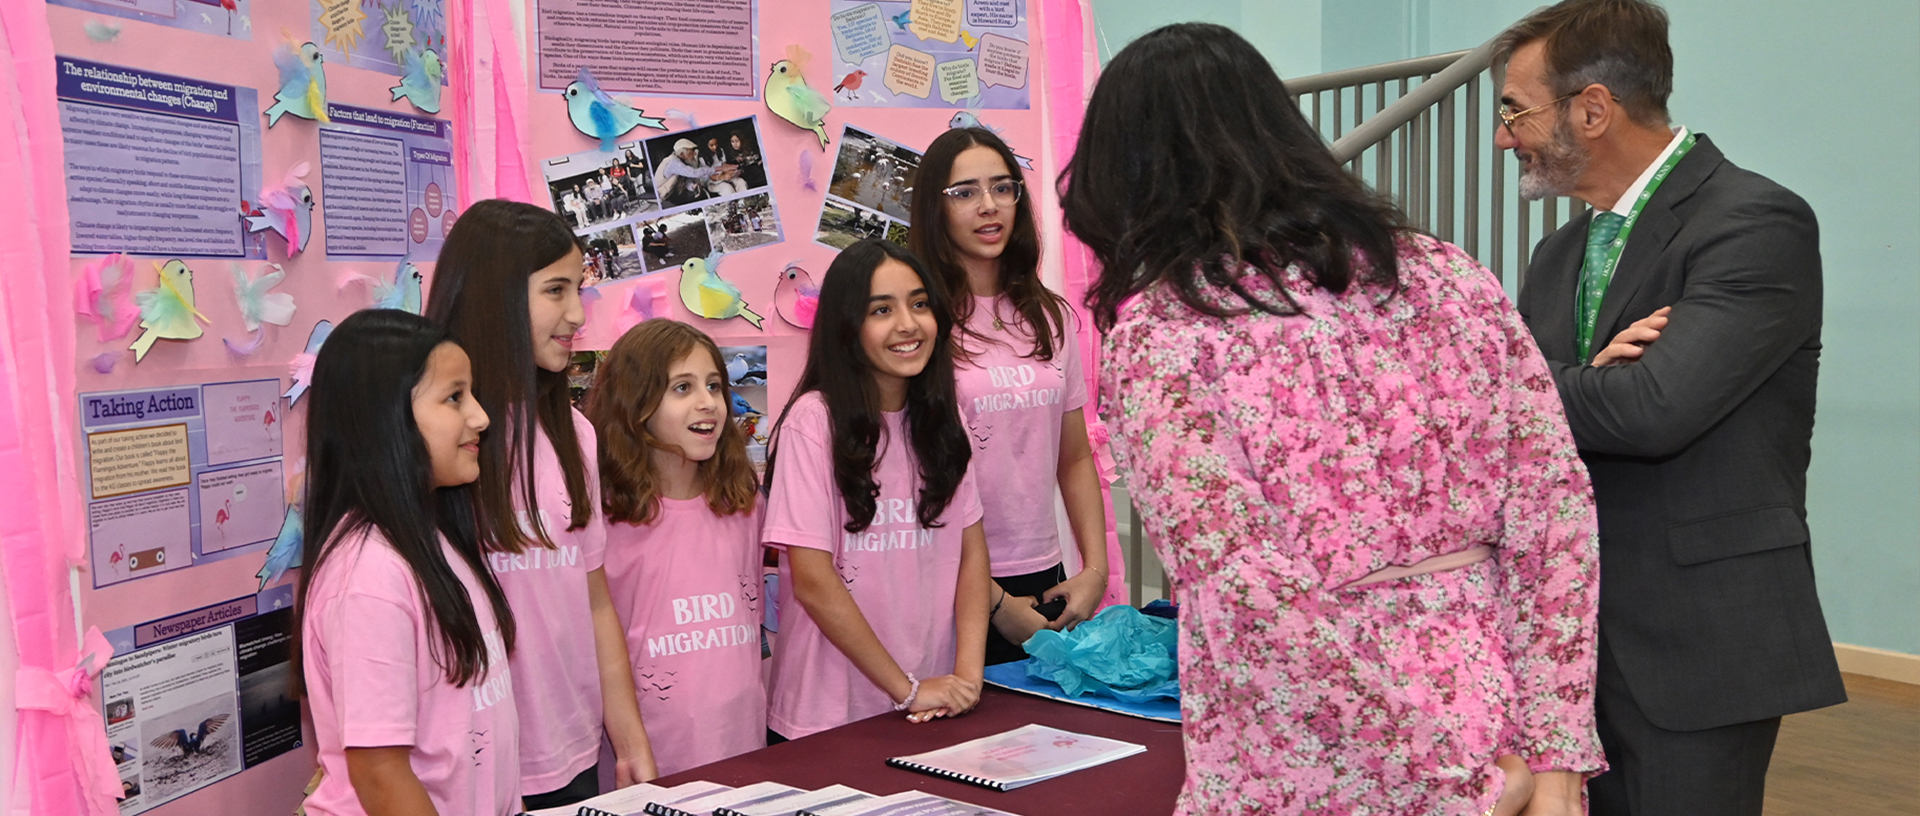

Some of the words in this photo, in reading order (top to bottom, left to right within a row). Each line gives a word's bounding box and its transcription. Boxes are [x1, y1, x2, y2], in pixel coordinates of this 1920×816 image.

[64, 62, 82, 76] The
[84, 67, 137, 88] relationship
[139, 74, 172, 91] between
[174, 81, 212, 97] migration
[214, 87, 227, 99] and
[81, 82, 146, 100] environmental
[148, 90, 181, 106] changes
[183, 95, 217, 113] (Change)
[988, 364, 1036, 388] BIRD
[90, 397, 144, 418] Taking
[147, 393, 194, 413] Action
[974, 388, 1061, 414] MIGRATION
[844, 528, 934, 552] MIGRATIN
[153, 616, 205, 638] Newspaper
[207, 605, 241, 623] Articles
[672, 592, 735, 625] BIRD
[648, 624, 756, 658] MIGRATION
